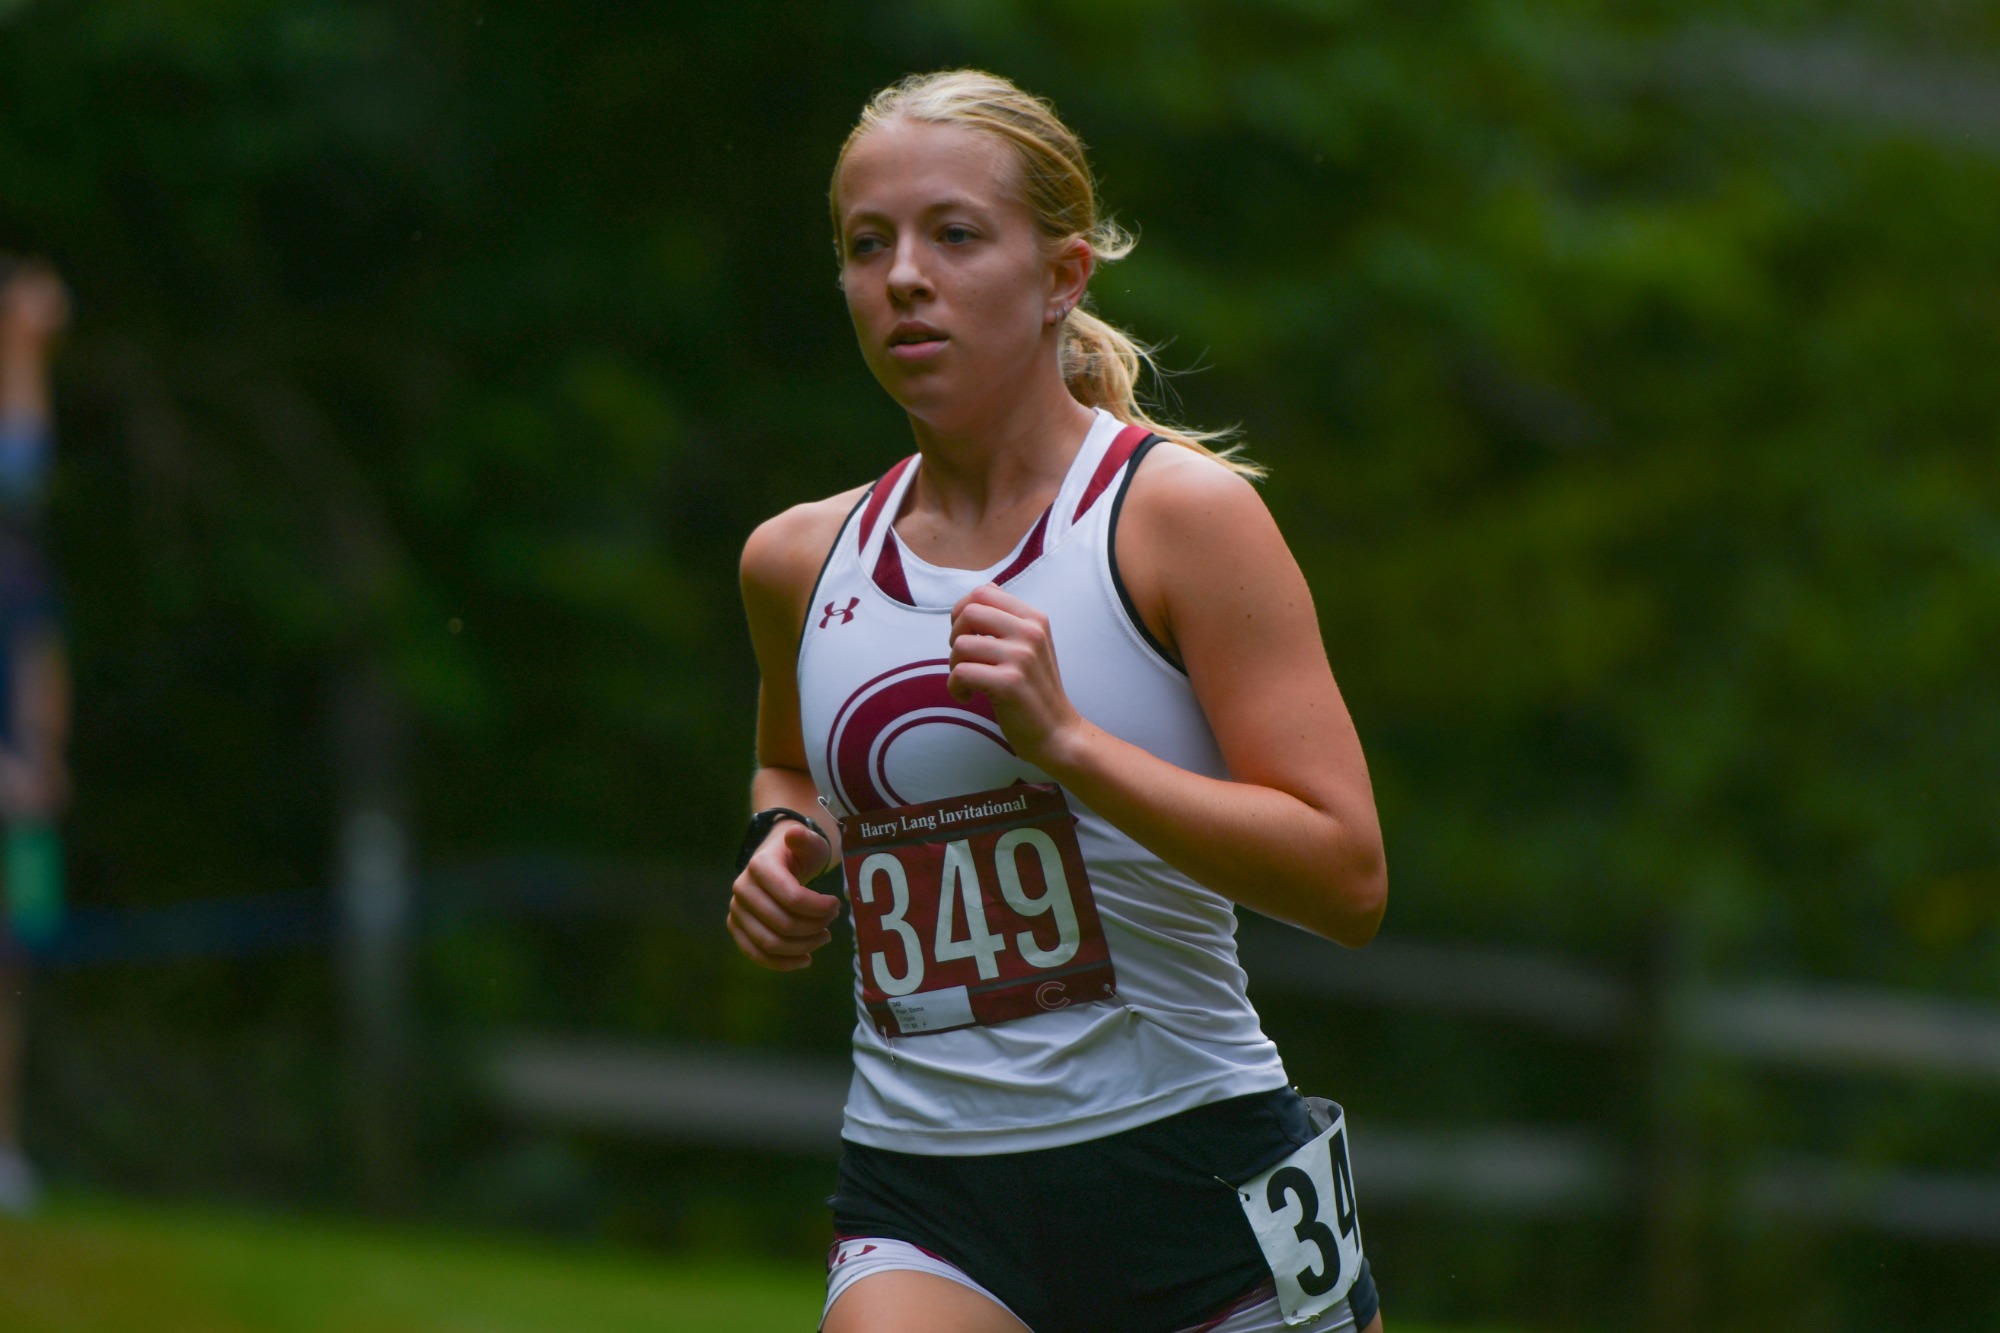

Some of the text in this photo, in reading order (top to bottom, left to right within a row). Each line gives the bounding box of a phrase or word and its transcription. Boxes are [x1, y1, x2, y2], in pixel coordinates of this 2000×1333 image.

[860, 794, 1028, 838] Harry Lang Invitational
[858, 827, 1081, 996] 349
